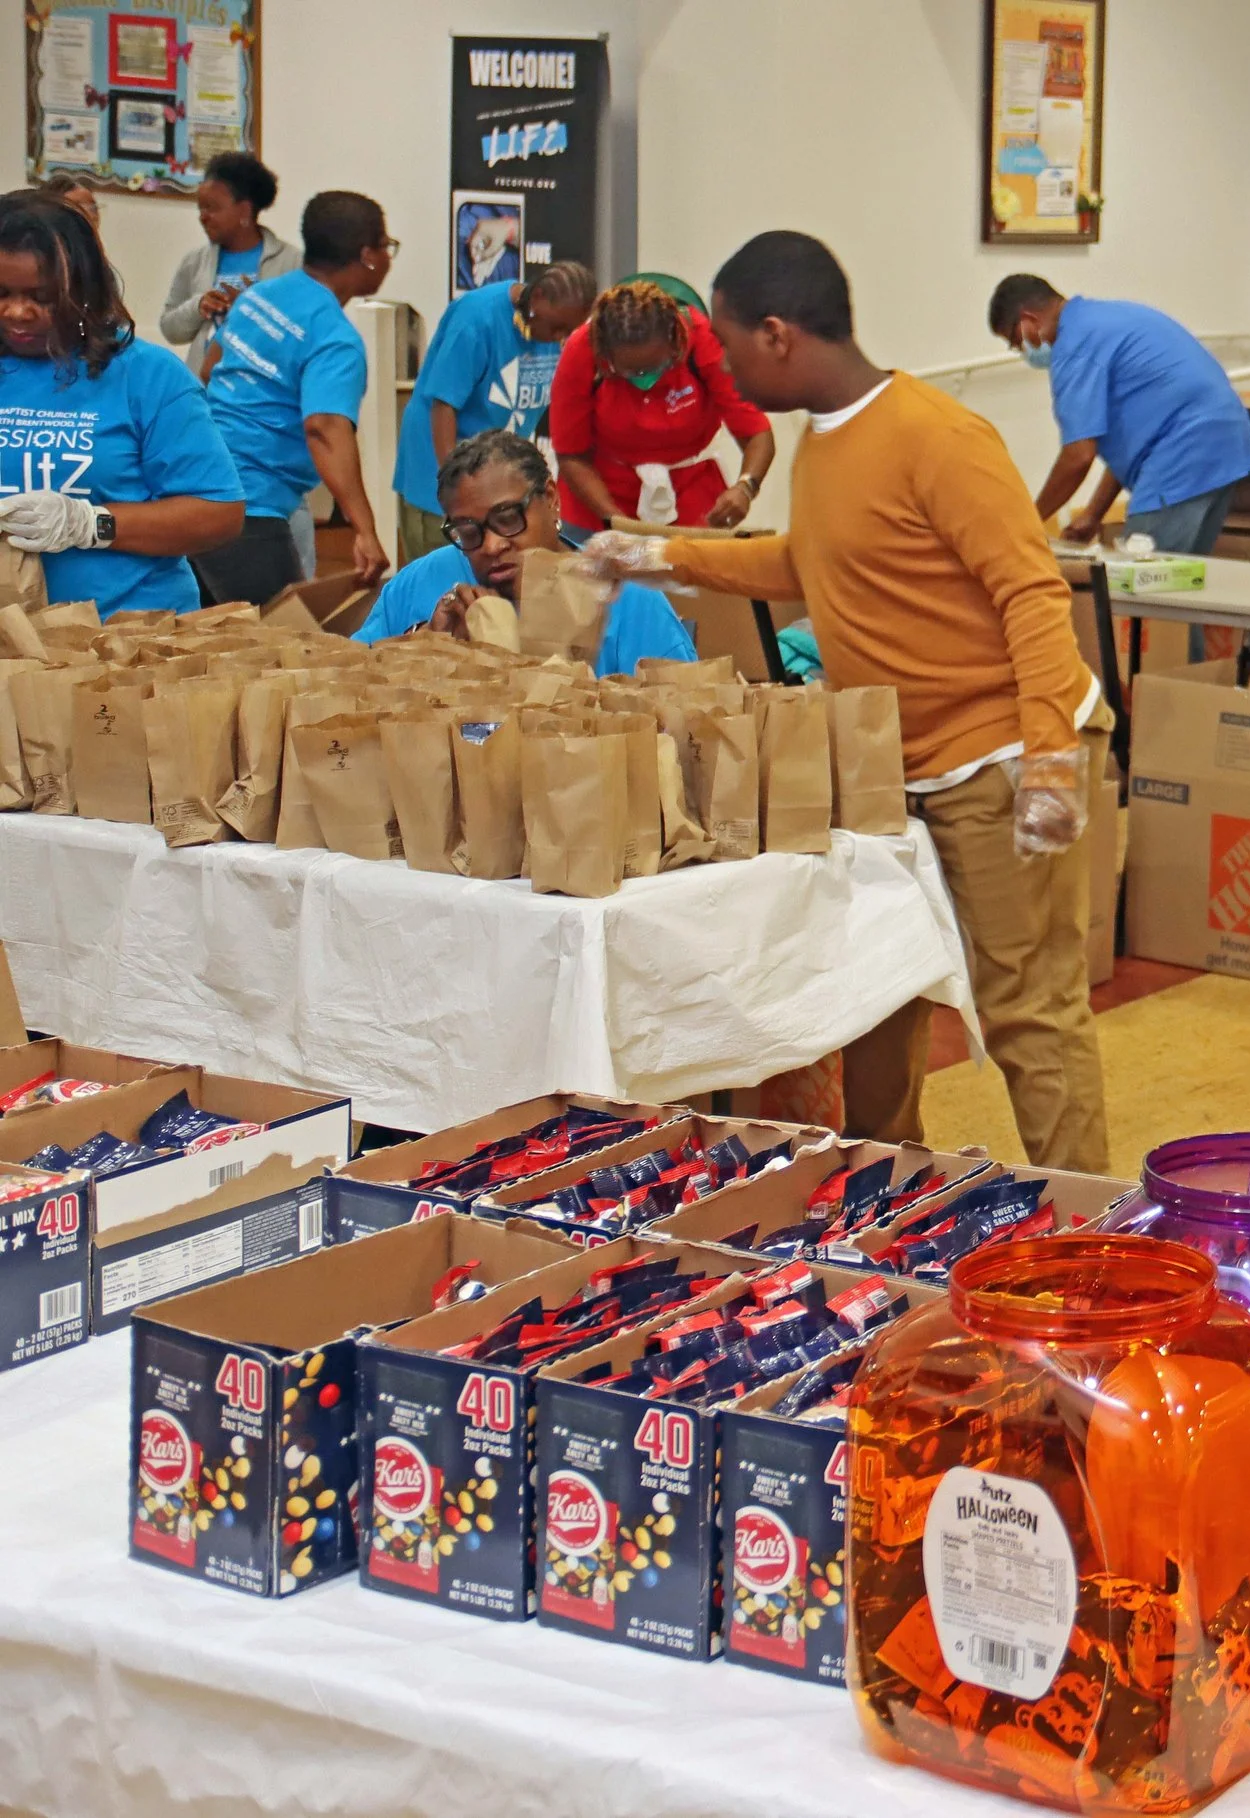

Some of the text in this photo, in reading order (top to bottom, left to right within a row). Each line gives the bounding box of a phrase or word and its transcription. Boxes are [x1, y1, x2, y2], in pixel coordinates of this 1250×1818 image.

[469, 50, 576, 89] WELCOME!
[525, 241, 552, 265] LOVE
[1136, 779, 1185, 801] LARGE
[1220, 935, 1249, 952] How
[1206, 953, 1227, 969] get
[12, 1208, 35, 1227] MIX
[36, 1192, 80, 1240] 40
[992, 1204, 1016, 1218] SWEET
[993, 1213, 1014, 1226] SALTY
[42, 1232, 77, 1251] Individual
[42, 1243, 78, 1260] 2oz Packs
[122, 1290, 137, 1302] 270
[31, 1333, 36, 1344] 2
[37, 1330, 45, 1342] OZ
[64, 1318, 83, 1332] PACKS
[12, 1349, 24, 1361] NET
[26, 1344, 35, 1357] WT
[36, 1342, 41, 1353] 5
[42, 1339, 53, 1352] LBS
[215, 1353, 265, 1414] 40
[456, 1373, 514, 1433] 40
[222, 1405, 262, 1427] Individual
[220, 1416, 263, 1439] 2oz Packs
[464, 1425, 511, 1444] Individual
[634, 1407, 694, 1469] 40
[463, 1438, 512, 1458] 2oz Packs
[641, 1462, 689, 1481] Individual
[640, 1475, 690, 1496] 2oz Packs
[735, 1529, 787, 1557] Kar's
